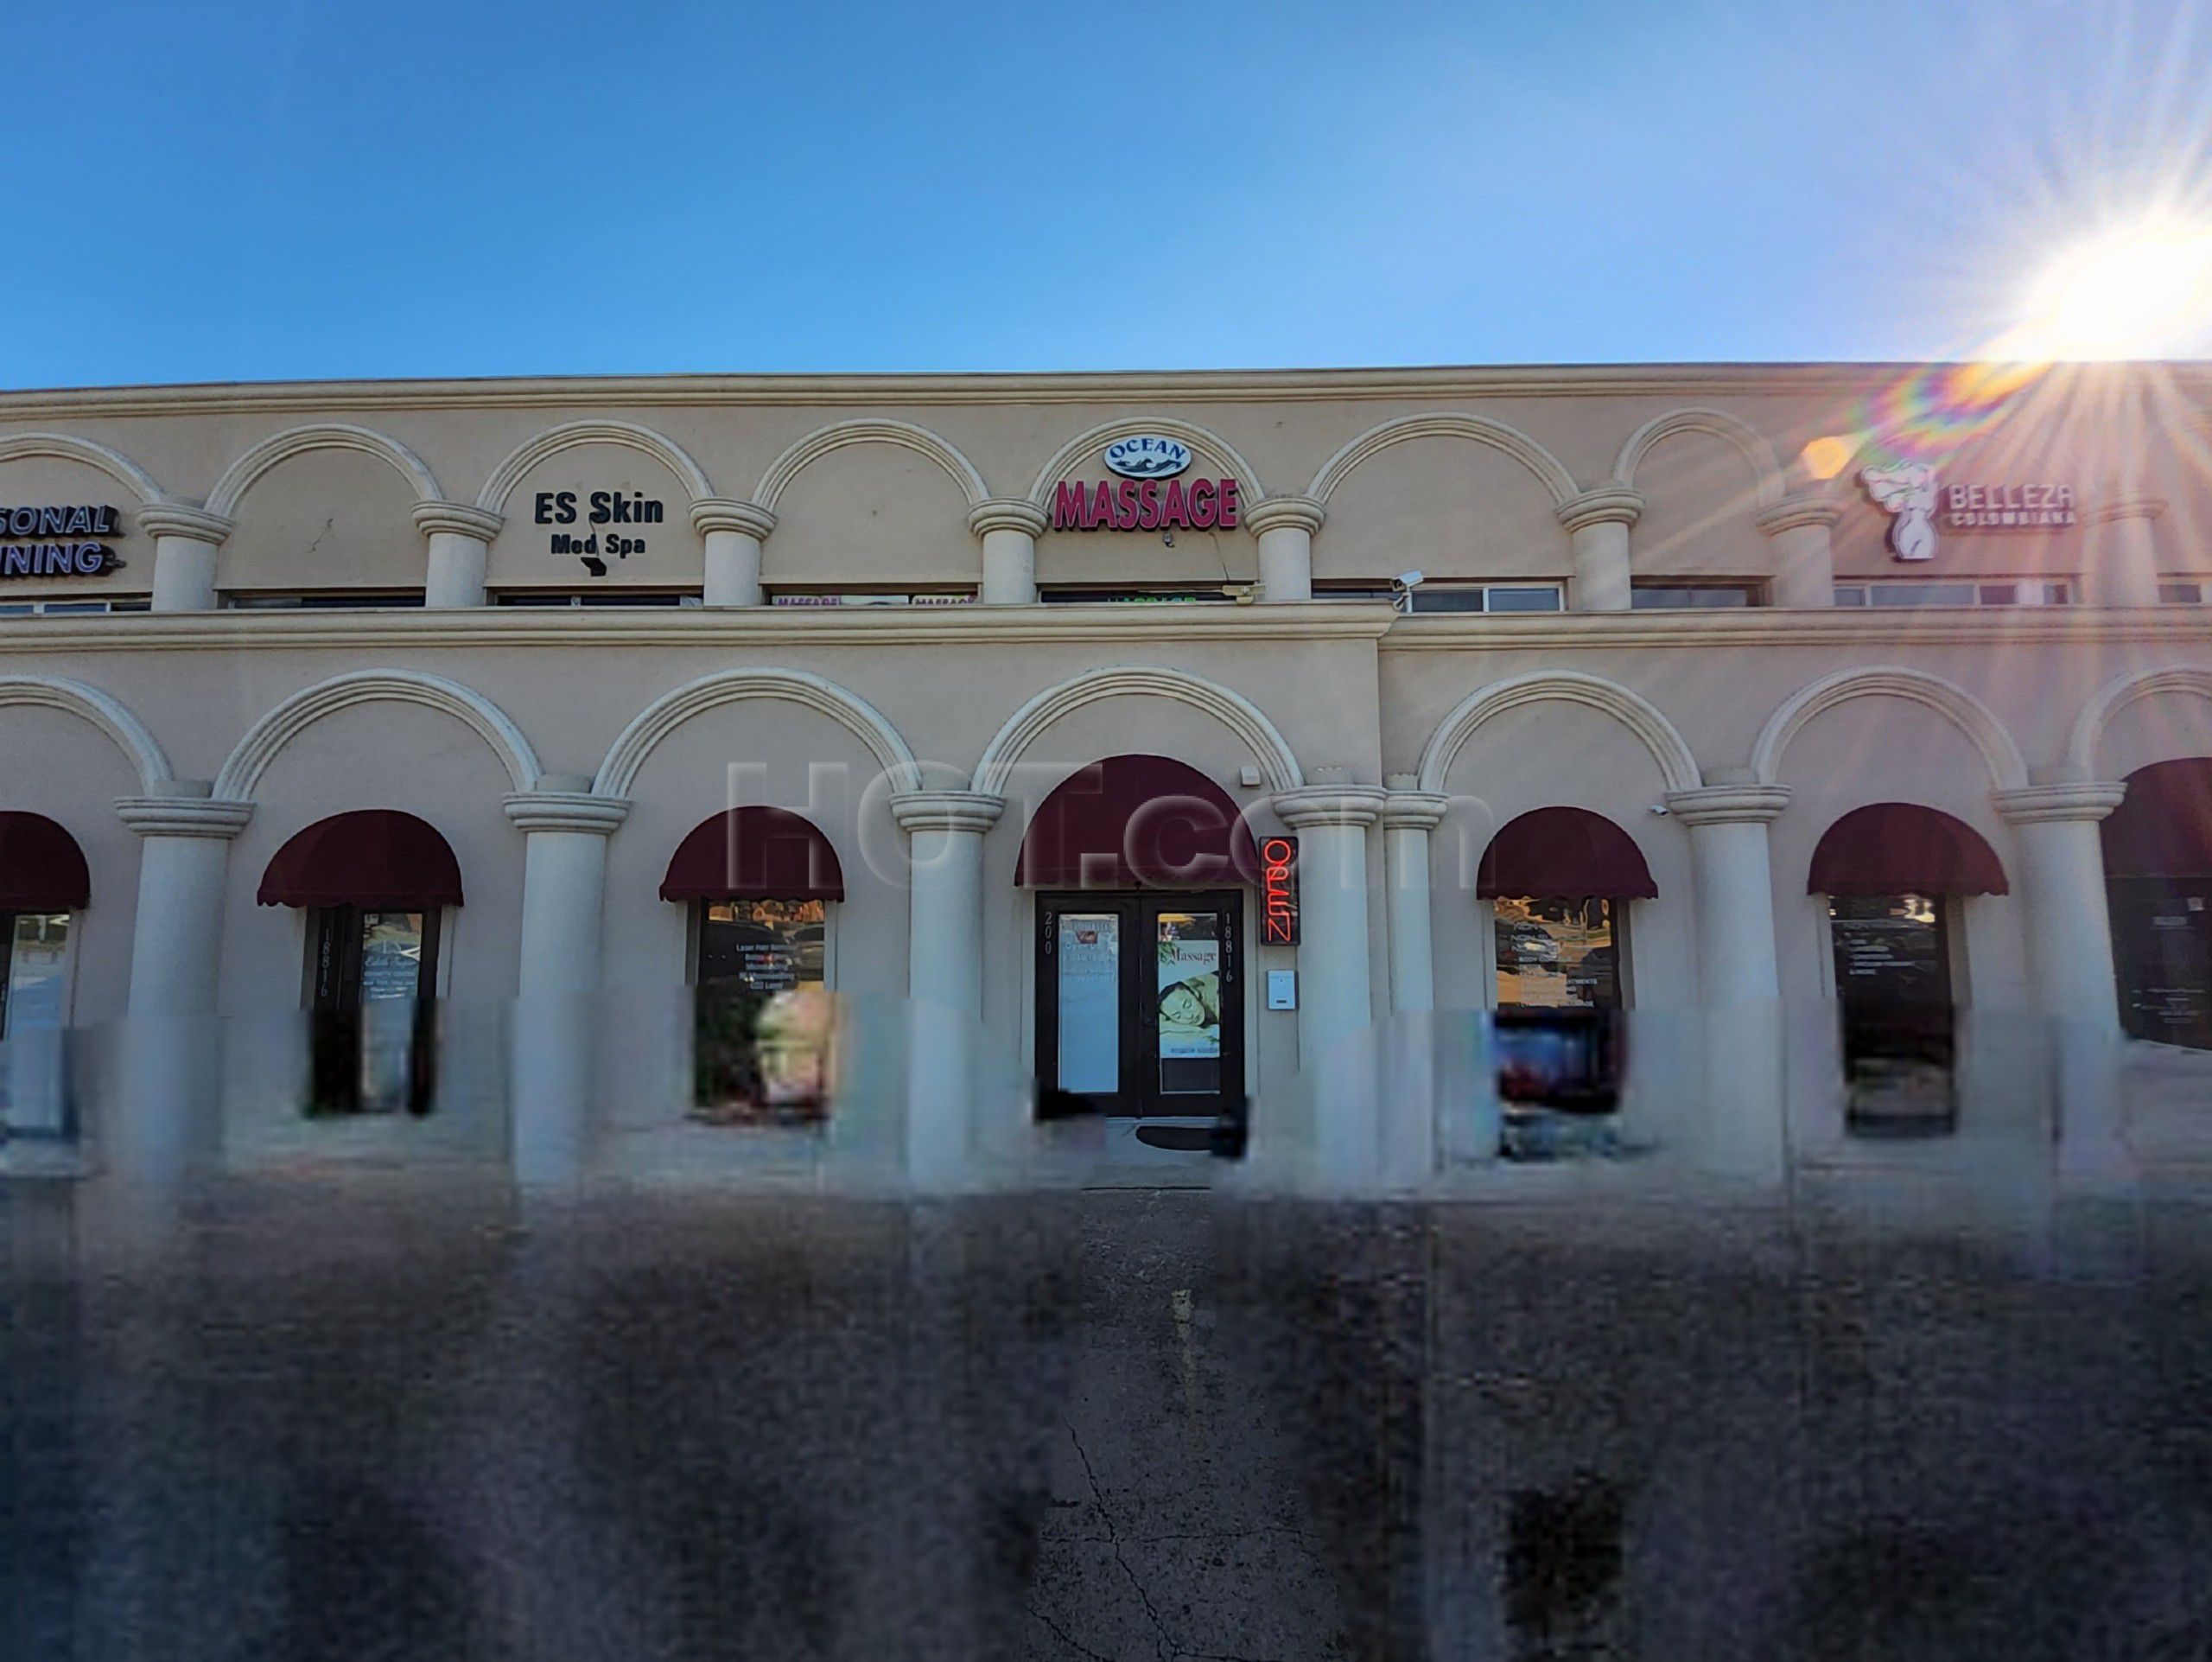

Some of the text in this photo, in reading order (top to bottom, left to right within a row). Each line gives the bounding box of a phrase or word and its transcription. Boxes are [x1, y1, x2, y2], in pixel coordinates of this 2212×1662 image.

[1109, 438, 1186, 460] OCEAN
[535, 491, 664, 524] ES Skin
[1053, 478, 1237, 530] MASSAGE
[1949, 484, 2074, 509] BELLEZA
[0, 505, 110, 535] ONAL
[0, 541, 103, 575] NING
[550, 533, 645, 559] Med Spa
[1264, 839, 1291, 942] OPEN
[1171, 946, 1217, 965] Massage
[1224, 912, 1234, 982] 18816
